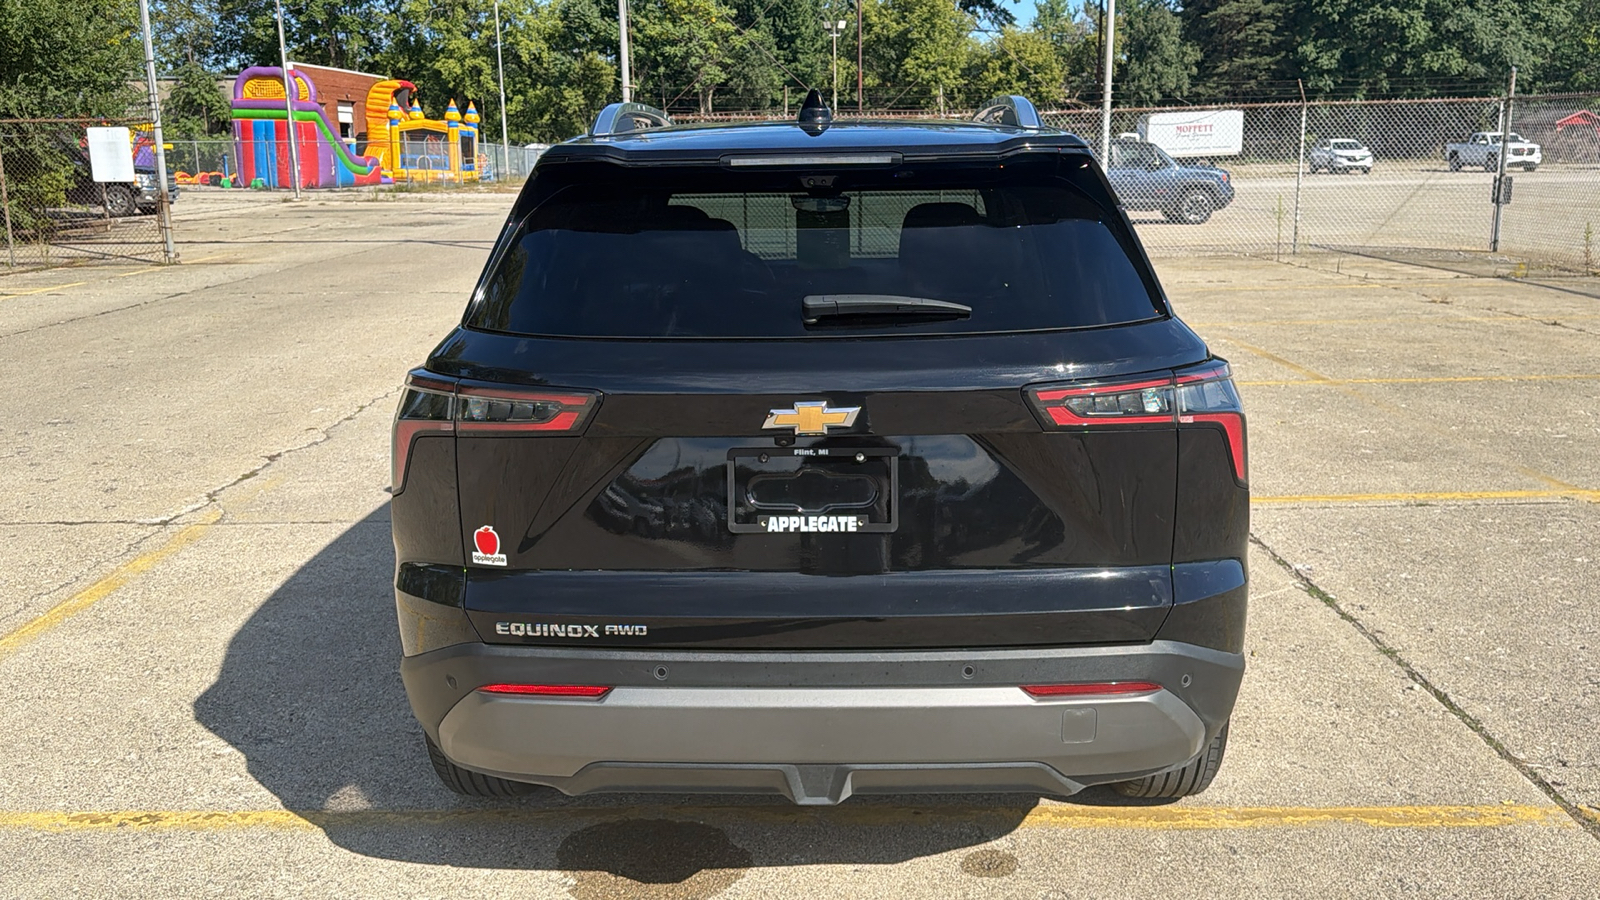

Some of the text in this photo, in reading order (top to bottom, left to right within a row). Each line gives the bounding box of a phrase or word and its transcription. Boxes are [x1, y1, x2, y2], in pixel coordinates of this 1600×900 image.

[1175, 124, 1213, 133] MOFFETT
[767, 516, 857, 532] APPLEGATE
[495, 622, 648, 637] EQUINOX AWD
